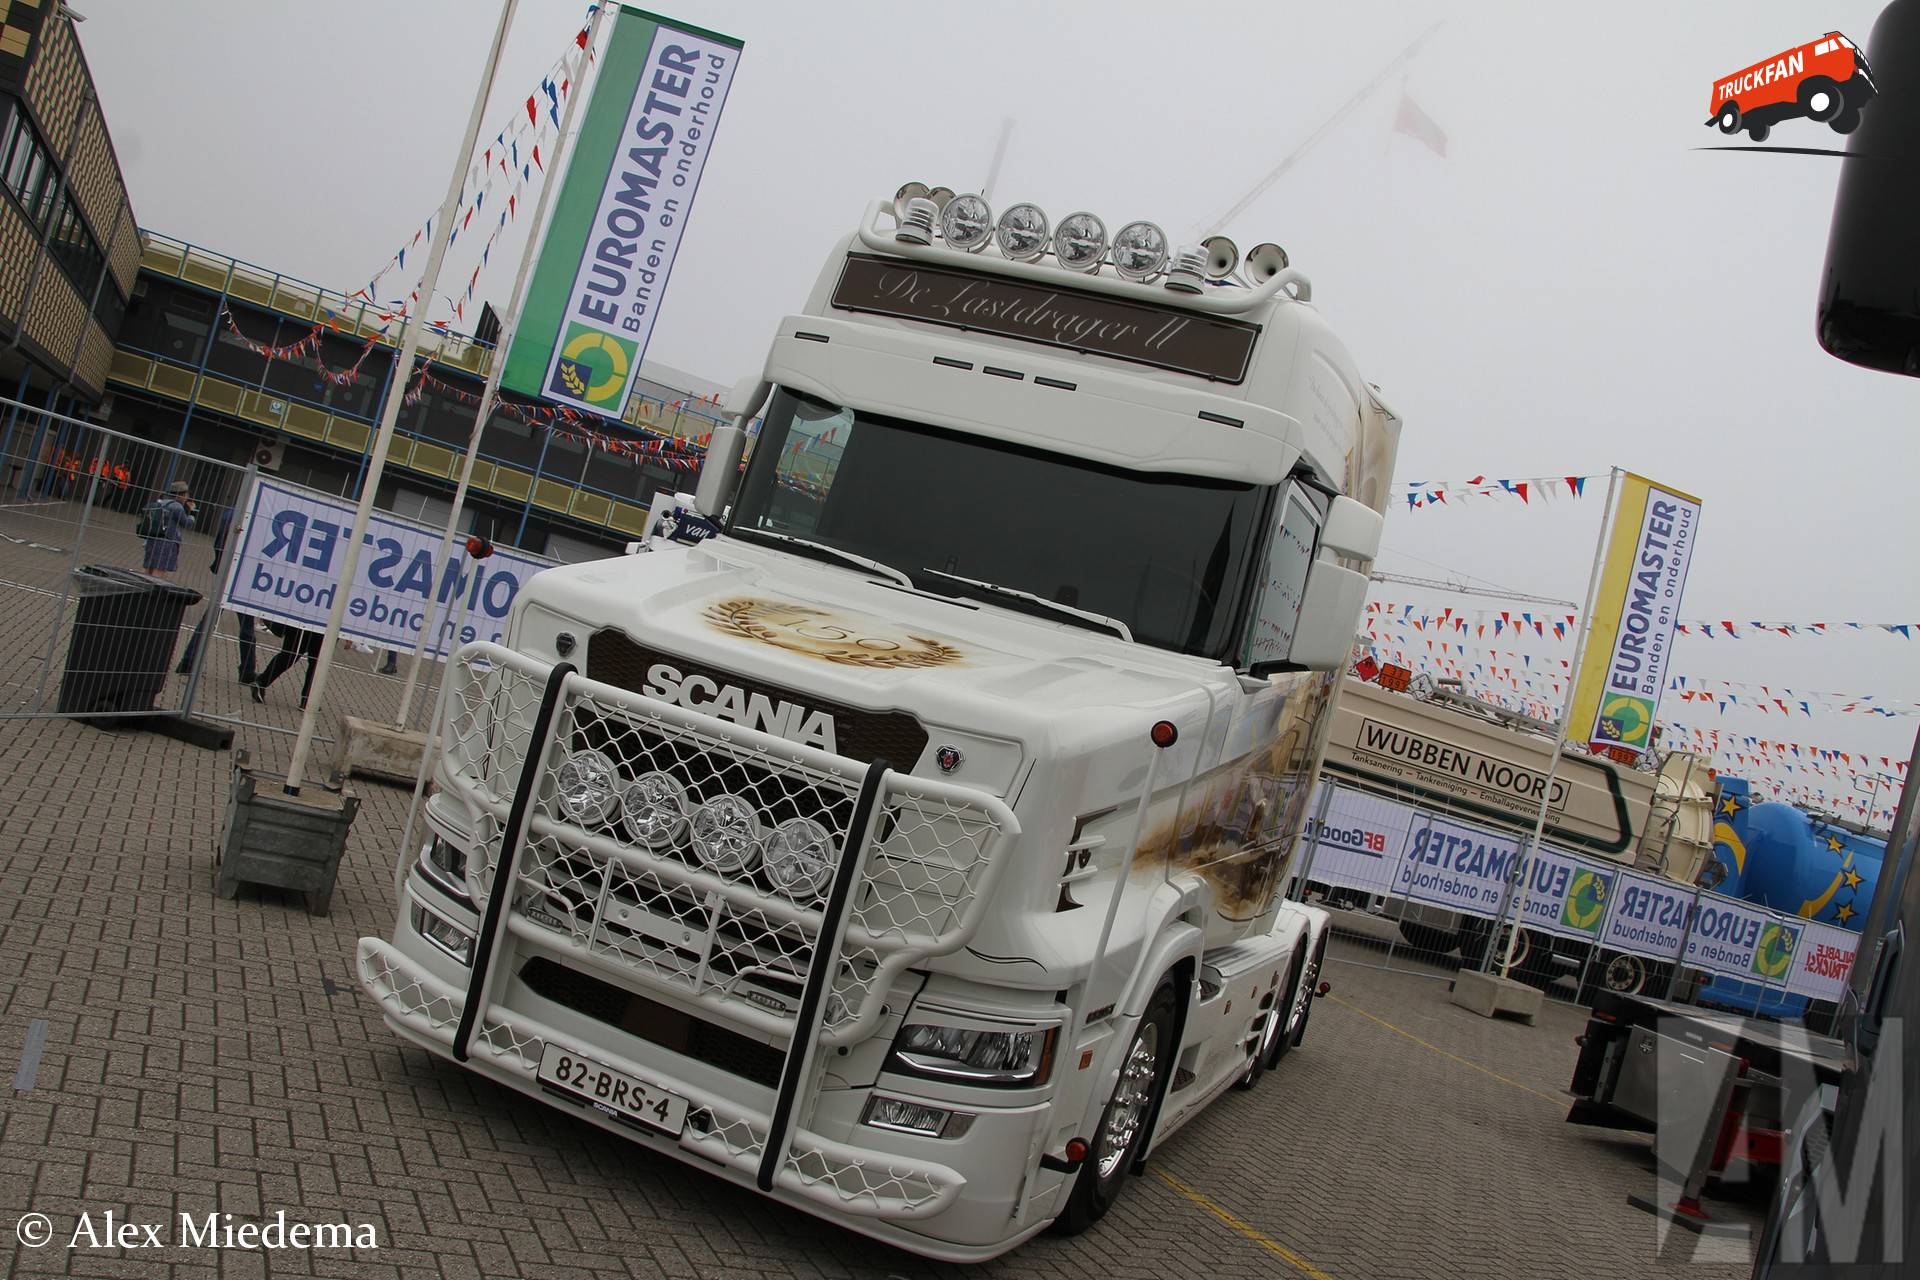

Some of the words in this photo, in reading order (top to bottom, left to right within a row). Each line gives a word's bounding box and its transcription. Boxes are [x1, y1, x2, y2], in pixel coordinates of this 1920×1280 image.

[578, 43, 700, 325] EUROMASTER
[621, 239, 666, 333] Banden
[659, 198, 679, 228] en
[672, 53, 726, 187] onderhoud
[873, 270, 930, 304] De
[931, 280, 1138, 344] Lastdrager
[1611, 499, 1678, 691] EUROMASTER
[1641, 633, 1665, 695] Banden
[1659, 605, 1670, 625] en
[1665, 507, 1692, 597] onderhoud
[642, 663, 838, 755] SCANIA
[1351, 751, 1403, 776] Tanksanering
[1415, 771, 1468, 796] Tankreiniging
[1366, 724, 1472, 776] WUBBEN
[1475, 760, 1564, 803] NOORD
[555, 1056, 672, 1122] 82-BRS-4
